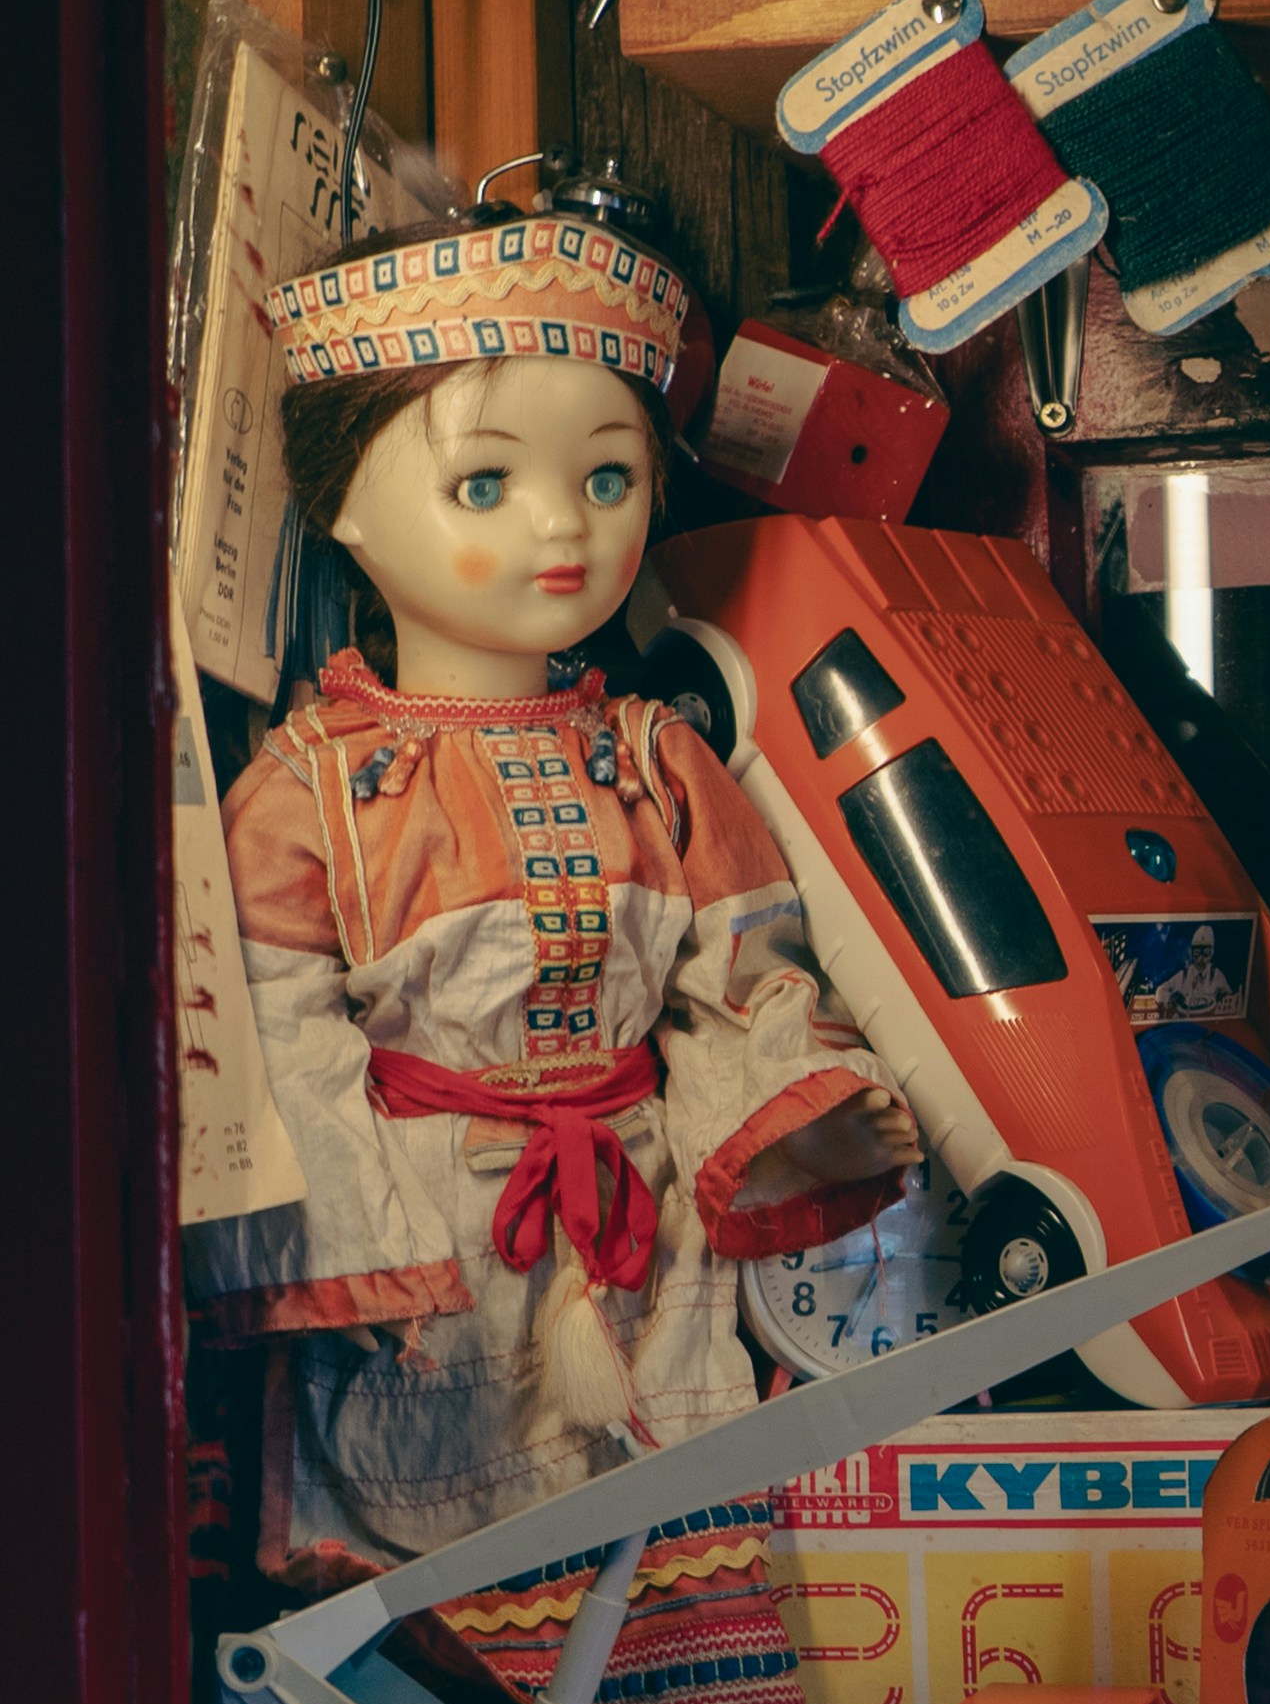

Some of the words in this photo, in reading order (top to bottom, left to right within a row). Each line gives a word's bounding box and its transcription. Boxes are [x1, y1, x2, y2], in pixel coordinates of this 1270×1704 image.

[814, 14, 928, 104] Stopfzwirn
[1034, 14, 1152, 97] Stopfzwirn
[1027, 228, 1043, 245] M
[217, 580, 235, 604] DDR
[946, 1190, 970, 1226] 2
[791, 1281, 817, 1317] 8
[826, 1314, 849, 1348] 7
[772, 1495, 887, 1510] PIELWAREN
[1226, 1516, 1249, 1529] VEB
